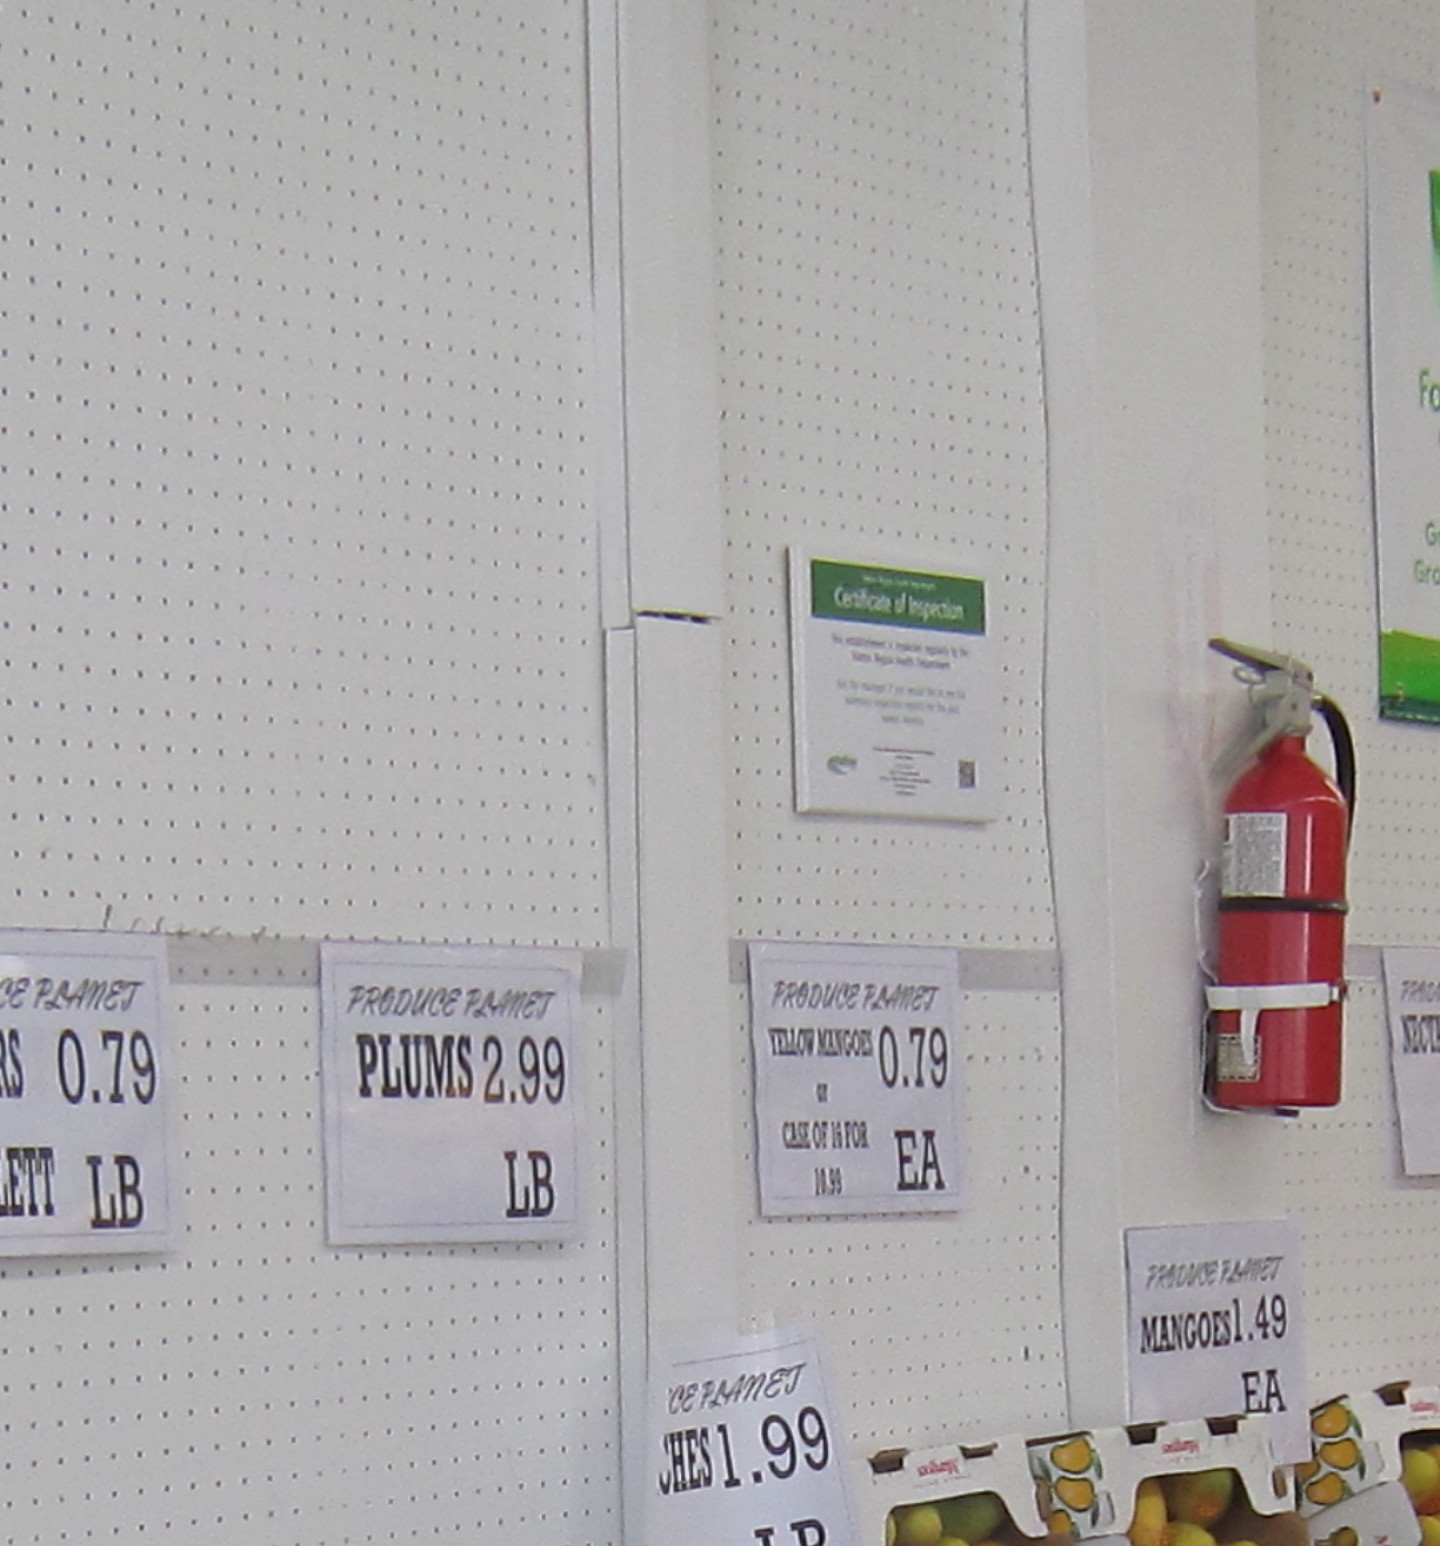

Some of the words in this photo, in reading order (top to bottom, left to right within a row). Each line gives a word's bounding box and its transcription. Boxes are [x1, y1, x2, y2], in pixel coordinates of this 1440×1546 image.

[34, 978, 144, 1011] PLANET
[347, 985, 461, 1017] PRODUCE
[464, 988, 557, 1019] PLANET
[772, 980, 861, 1009] PRODUCE
[863, 983, 940, 1012] PLANET
[58, 1029, 157, 1104] 0.79
[356, 1033, 474, 1098] PLUMS
[482, 1035, 566, 1105] 2.99
[878, 1025, 949, 1089] 0.79
[782, 1121, 811, 1150] CASE
[813, 1121, 827, 1149] OF
[844, 1121, 869, 1150] FOR
[894, 1130, 946, 1191] EA
[86, 1155, 145, 1229] LB
[503, 1151, 555, 1218] LB
[1140, 1309, 1231, 1354] MANGOES
[1232, 1293, 1287, 1343] 1.49
[702, 1362, 807, 1411] PLANET
[1241, 1369, 1287, 1413] EA
[717, 1406, 829, 1489] 1.99
